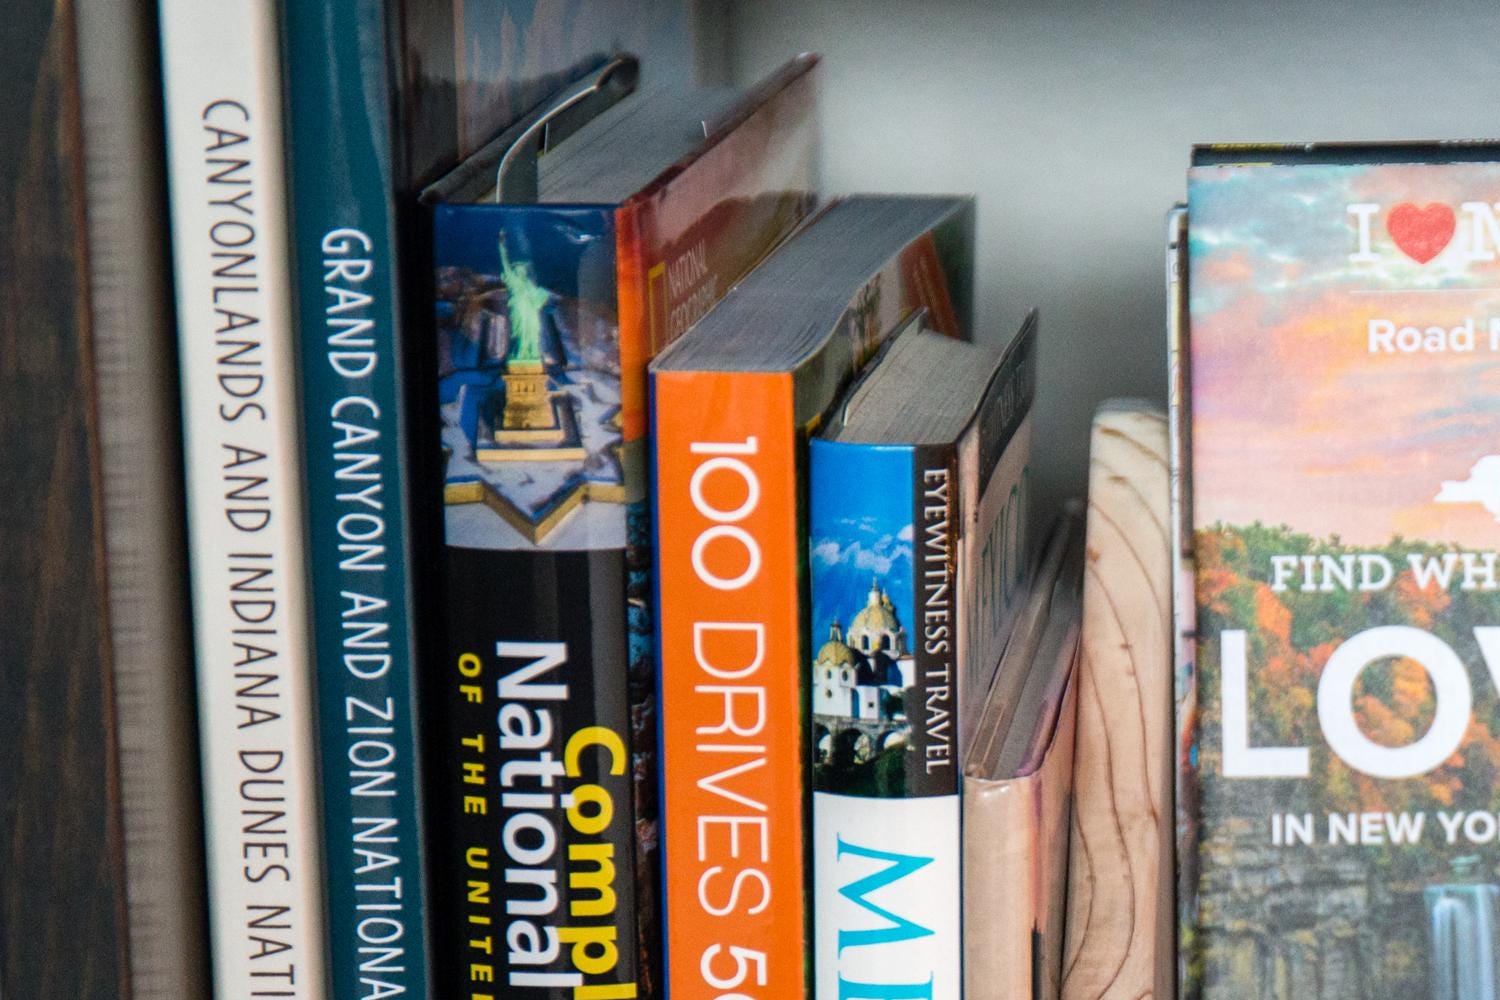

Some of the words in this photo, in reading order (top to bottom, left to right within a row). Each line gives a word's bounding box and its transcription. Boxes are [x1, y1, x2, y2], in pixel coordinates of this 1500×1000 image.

[202, 98, 267, 423] CANYONLANDS
[321, 227, 377, 379] GRAND
[1368, 315, 1476, 353] Road
[222, 444, 272, 533] AND
[330, 395, 386, 571] CANYON
[689, 435, 762, 591] 100
[924, 468, 950, 655] EYEWITNESS
[1269, 552, 1394, 593] FIND
[228, 553, 282, 730] INDIANA
[340, 590, 392, 680] AND
[457, 652, 483, 705] OF
[345, 696, 397, 797] ZION
[461, 735, 487, 815] THE
[693, 621, 772, 917] DRIVES
[925, 663, 950, 774] TRAVEL
[238, 750, 291, 884] DUNES
[495, 640, 585, 989] National
[1271, 813, 1314, 847] IN
[1328, 811, 1426, 846] NEW
